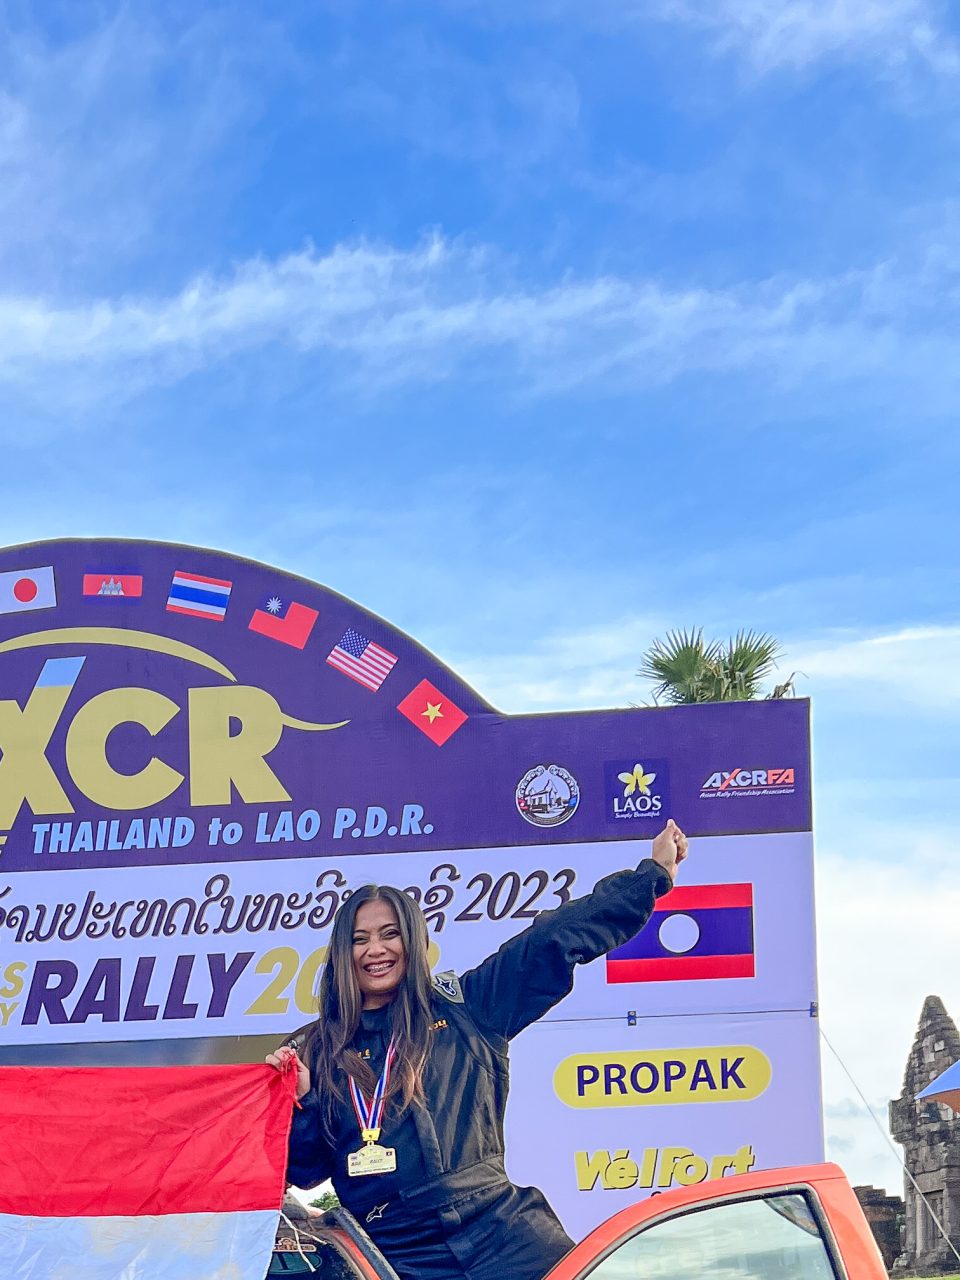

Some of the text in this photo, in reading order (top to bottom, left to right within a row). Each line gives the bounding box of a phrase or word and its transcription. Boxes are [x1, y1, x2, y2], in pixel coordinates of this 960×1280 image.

[702, 768, 794, 790] AXCRFA
[613, 796, 662, 813] LAOS
[32, 803, 435, 855] THAILAND to LAO P.D.R.
[21, 951, 256, 1026] RALLY
[576, 1056, 747, 1097] PROPAK
